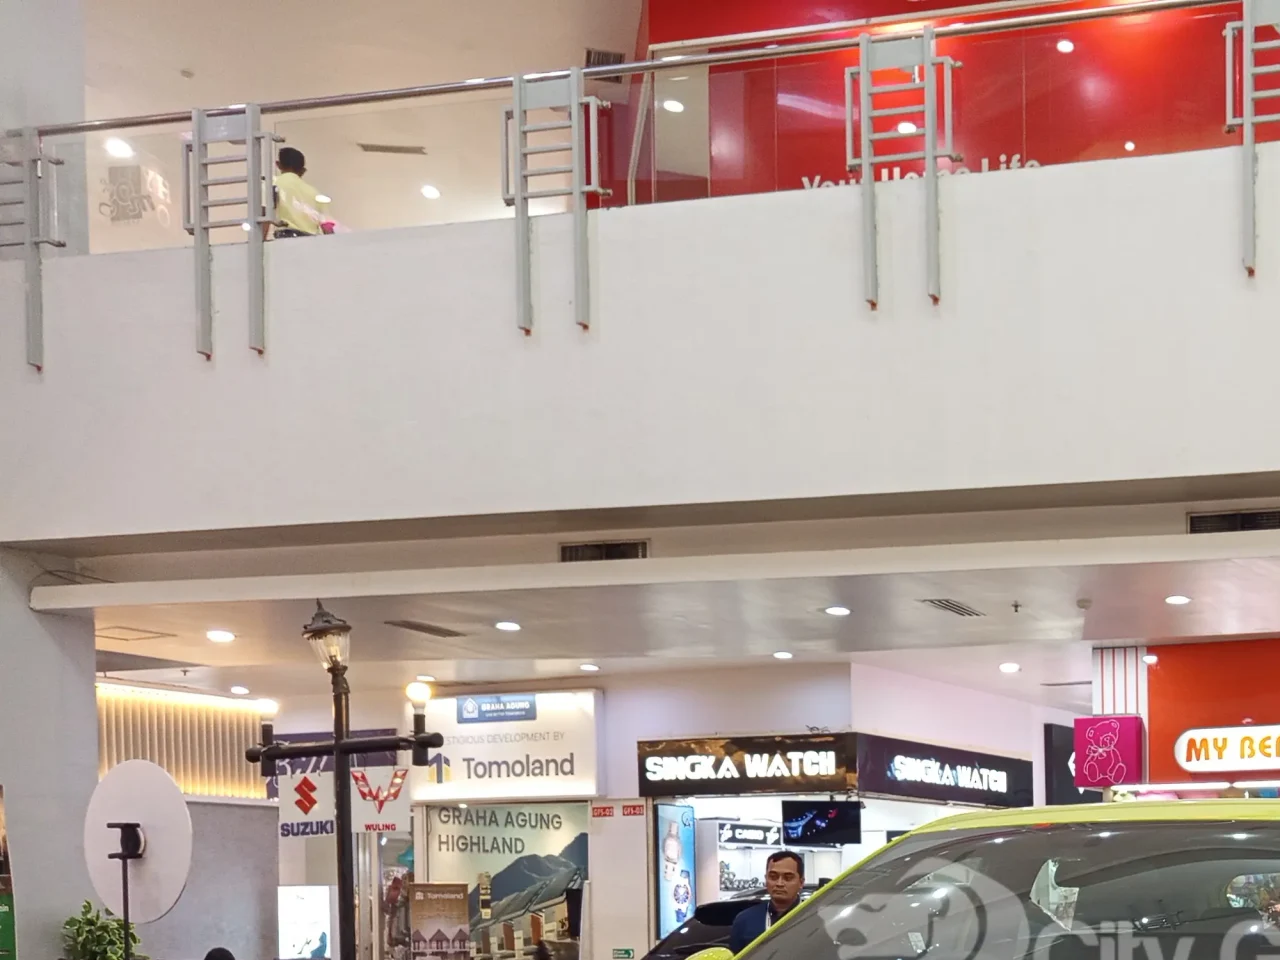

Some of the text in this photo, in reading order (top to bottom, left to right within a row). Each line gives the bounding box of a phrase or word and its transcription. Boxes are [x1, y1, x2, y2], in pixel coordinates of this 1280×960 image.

[486, 732, 550, 744] DEVELOPMENT
[553, 732, 565, 741] BY
[1186, 737, 1228, 762] MY
[462, 752, 575, 779] Tomoland
[645, 750, 836, 781] SINGKA WATCH
[893, 755, 953, 787] SINGKA
[280, 820, 334, 837] SUZUKI
[365, 824, 396, 832] WULING
[438, 806, 562, 830] GRAHA AGUNG
[438, 834, 525, 854] HIGHLAND
